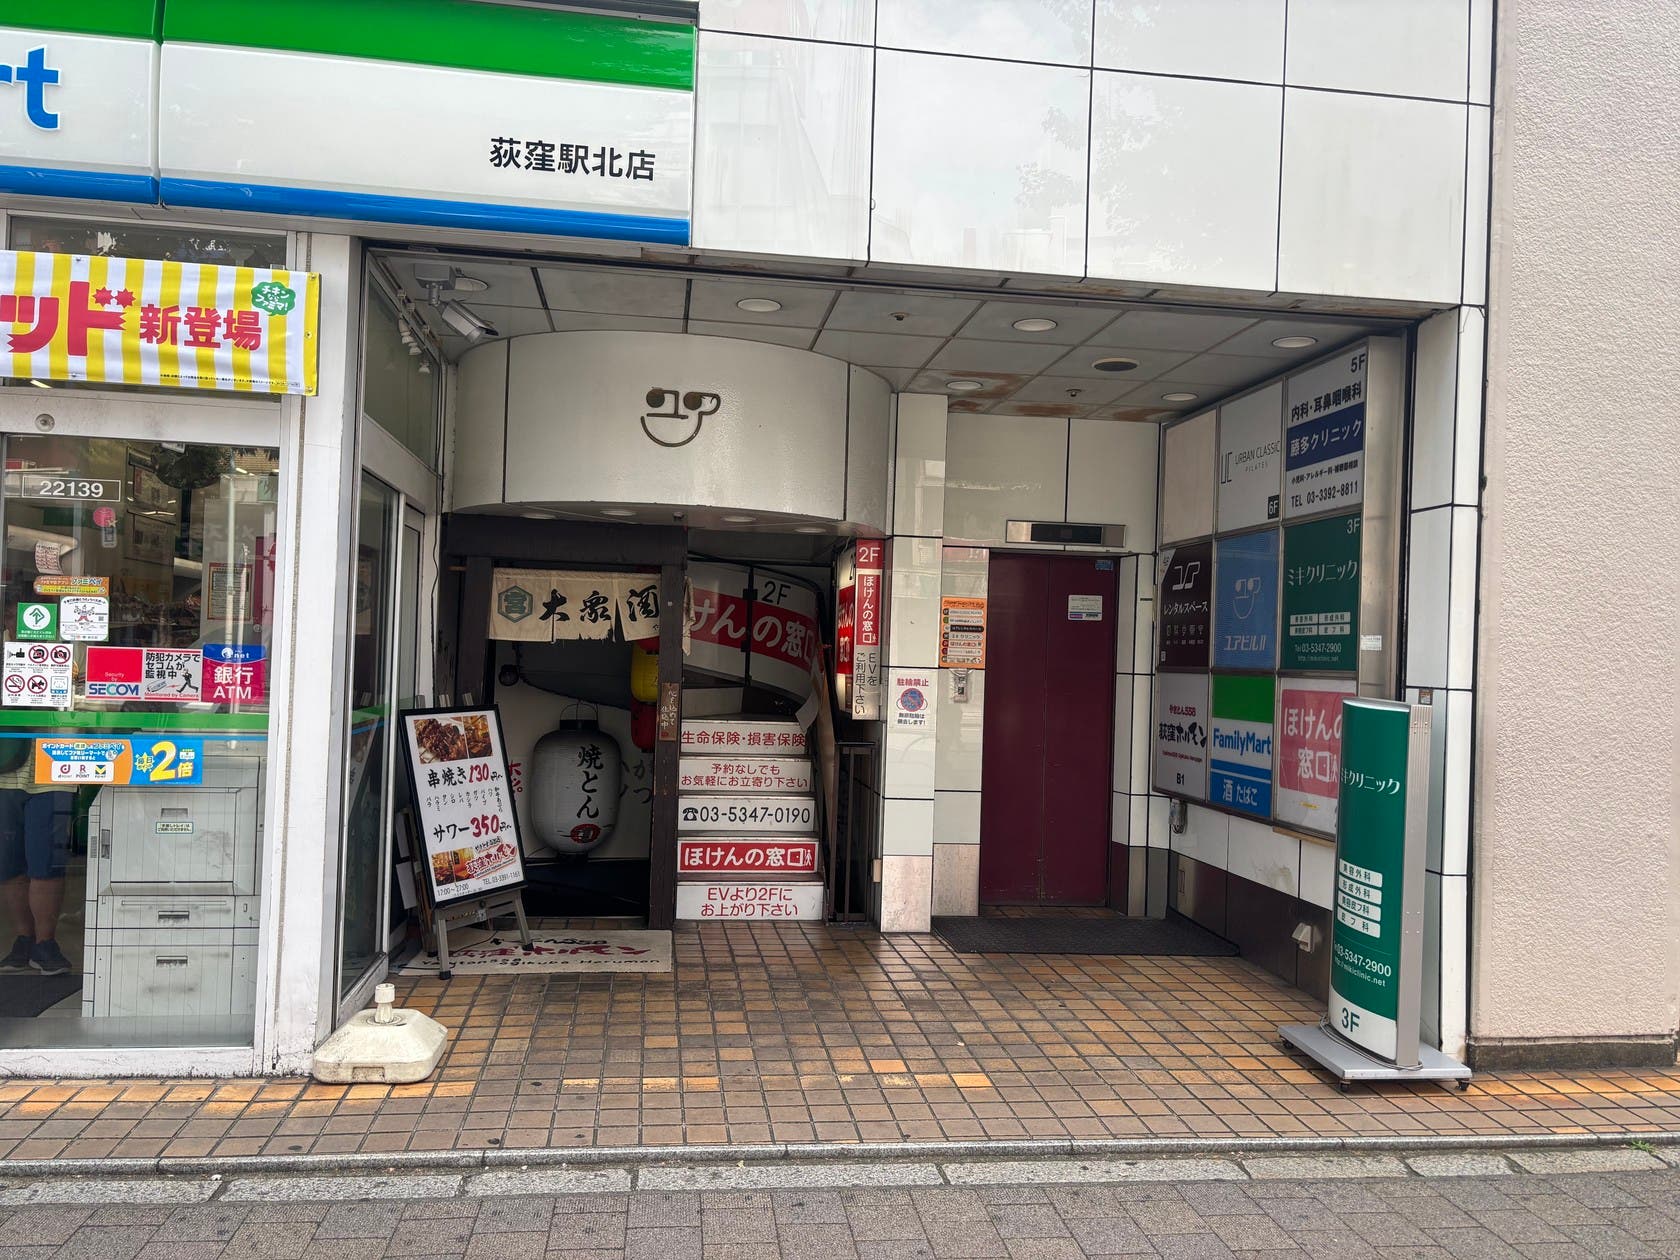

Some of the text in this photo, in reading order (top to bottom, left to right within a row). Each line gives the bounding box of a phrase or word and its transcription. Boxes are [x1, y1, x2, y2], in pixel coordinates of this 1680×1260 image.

[488, 136, 656, 182] 荻窪駅北店
[262, 285, 290, 299] チキン
[255, 294, 288, 311] ファミマ!
[140, 304, 262, 351] 新登場
[1350, 354, 1366, 373] 5F
[1291, 381, 1362, 423] 内科・耳鼻咽喉科
[1235, 440, 1280, 465] URBAN CLASSIC
[39, 480, 104, 497] 22139
[1291, 480, 1358, 509] TEL 03-3392-8811
[1269, 500, 1279, 515] 6F
[1346, 518, 1360, 535] 3F
[859, 547, 880, 563] 2F
[1288, 560, 1358, 586] ミキクリニック
[762, 581, 791, 606] 2F
[862, 576, 873, 643] ほけんの窓口
[1164, 601, 1208, 616] レンタルスペース
[145, 652, 200, 663] 防犯カメラで
[1301, 643, 1342, 653] 03-5347-2900
[104, 671, 125, 679] Security
[145, 661, 186, 672] セコムが
[145, 669, 178, 680] 監視中
[214, 665, 254, 685] 銀行
[866, 653, 878, 687] EVを
[88, 683, 139, 697] SECOM
[213, 687, 252, 700] ATM
[854, 653, 866, 714] ご利用下さい
[681, 730, 805, 747] 生命保険・損害保険
[1159, 721, 1207, 749] 荻窪ホルモン
[1213, 727, 1271, 756] FamilyMart
[711, 763, 781, 775] 予約なしでも
[1297, 746, 1331, 783] 窓口
[427, 766, 467, 790] 串焼き
[576, 743, 604, 819] 焼とん
[681, 774, 808, 789] お気軽にお立寄り下さい
[1176, 773, 1185, 786] B1
[1222, 779, 1258, 806] 酒 たばこ
[700, 805, 811, 824] 03-5347-0190
[433, 823, 470, 844] サワー
[684, 846, 805, 868] ほけんの窓口
[1342, 863, 1372, 883] 美容外科
[707, 887, 793, 901] EVより2Fに
[1342, 879, 1371, 899] 形成外科
[701, 903, 798, 917] お上がり下さい
[1341, 896, 1370, 916] 美容皮フ科
[1341, 1007, 1361, 1033] 3F
